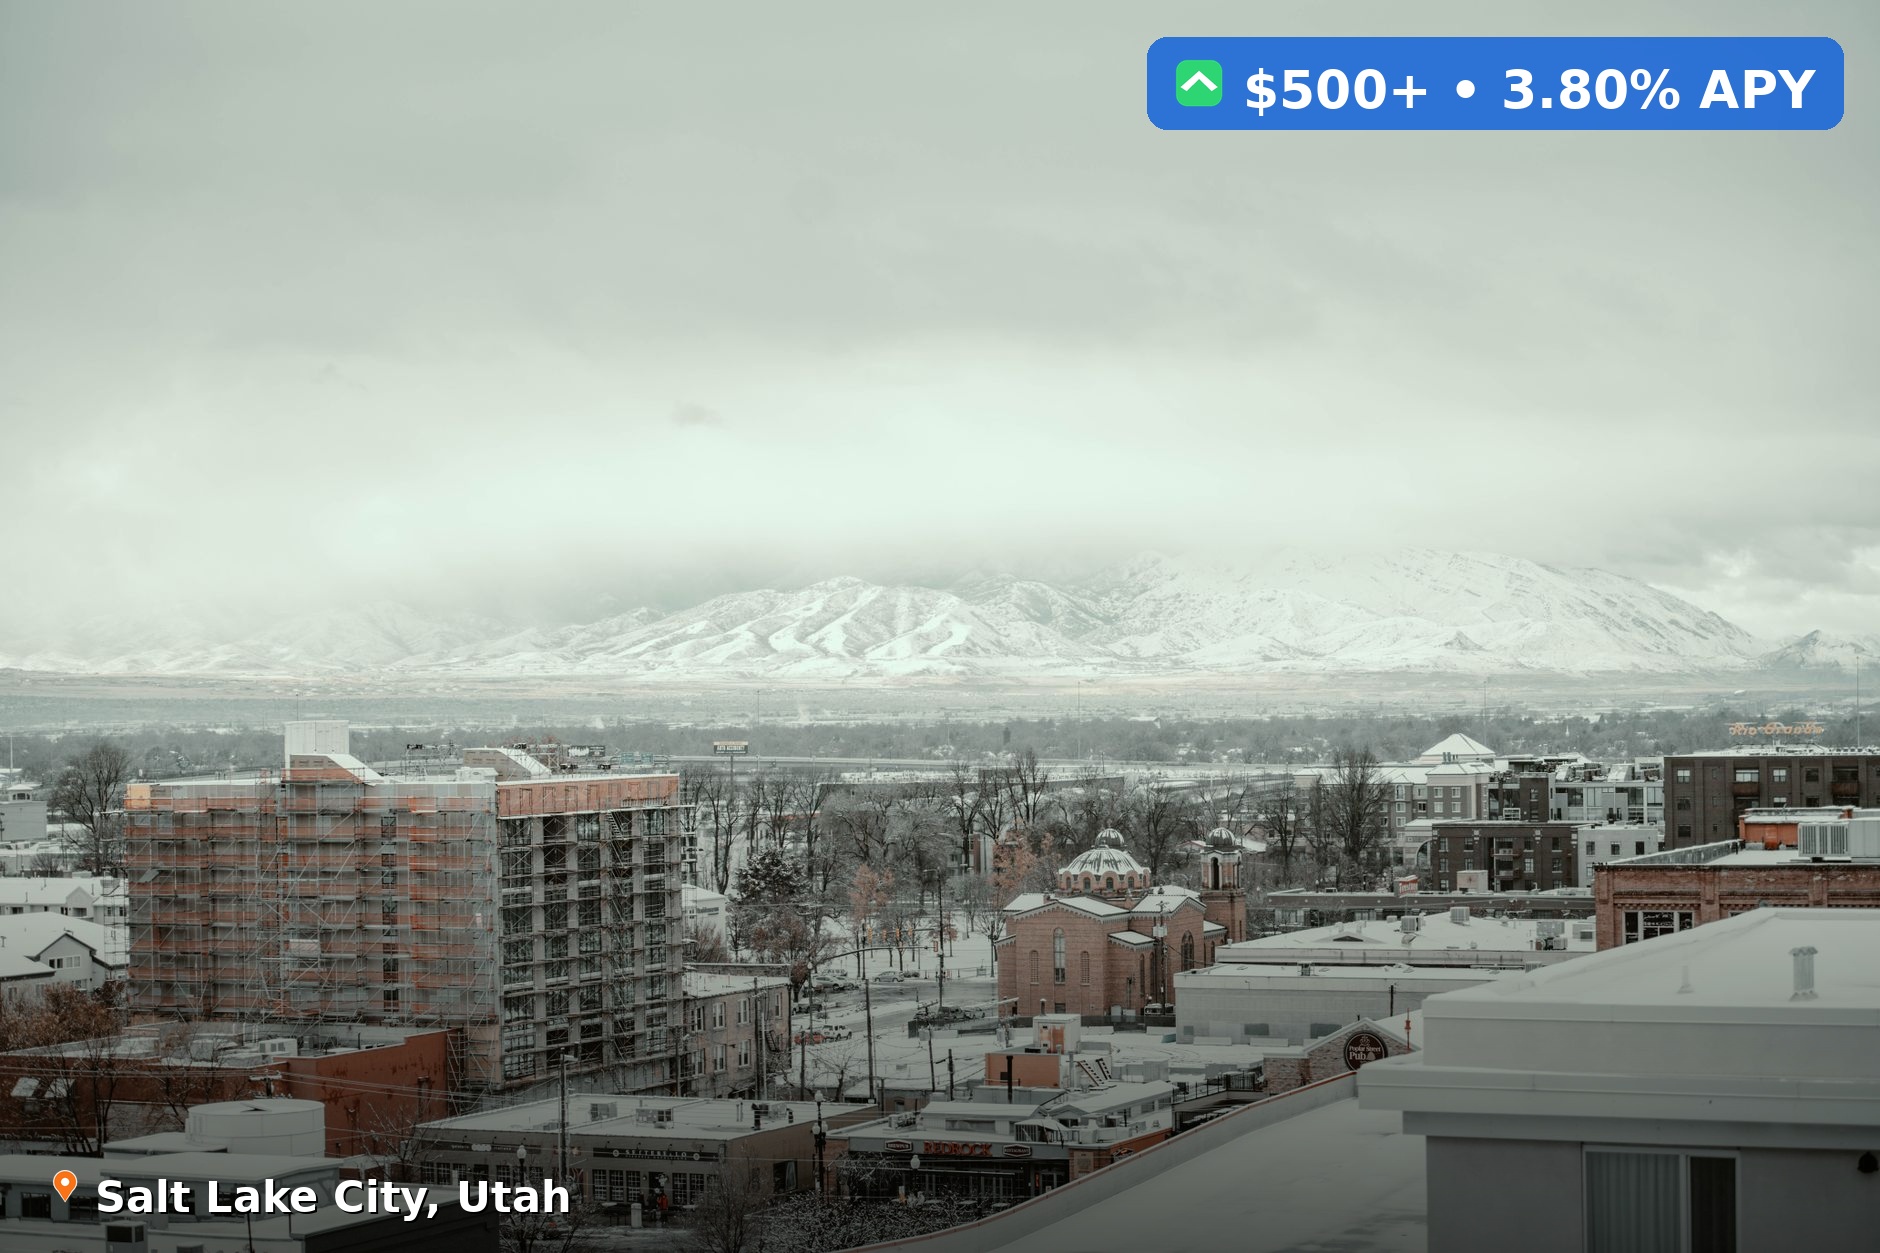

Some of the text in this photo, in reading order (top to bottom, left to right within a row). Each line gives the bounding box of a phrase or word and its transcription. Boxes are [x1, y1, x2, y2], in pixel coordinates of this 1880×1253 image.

[1728, 722, 1758, 736] Rio
[1349, 1051, 1367, 1060] Pub
[923, 1140, 993, 1157] REDROCK
